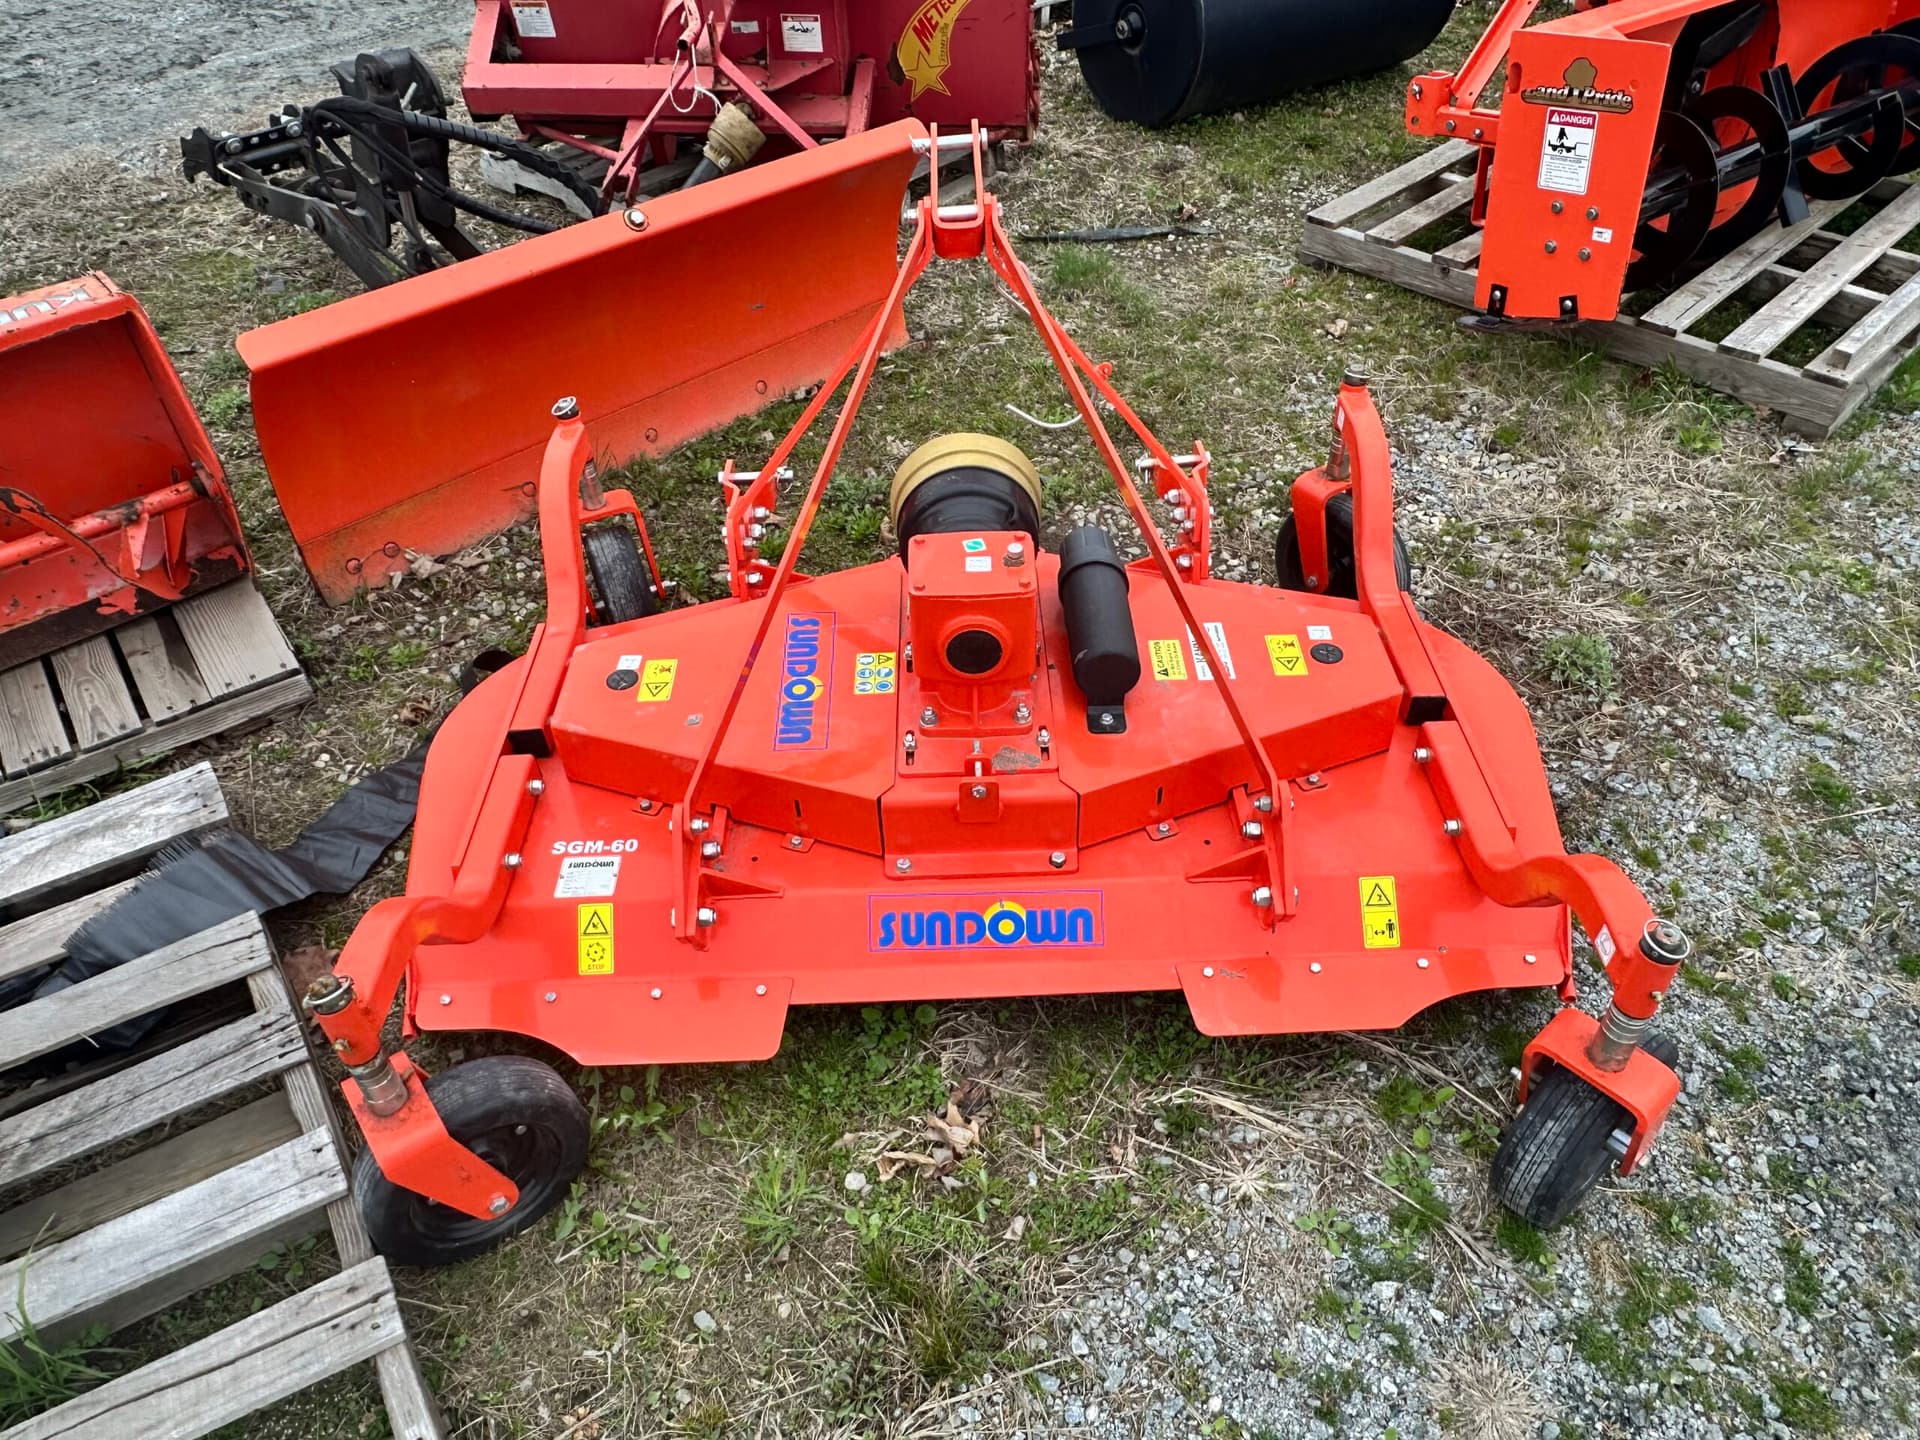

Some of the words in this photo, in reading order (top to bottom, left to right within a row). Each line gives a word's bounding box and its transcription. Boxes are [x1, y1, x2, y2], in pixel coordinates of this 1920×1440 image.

[1584, 87, 1632, 102] Pride
[1560, 113, 1593, 126] DANGER
[1153, 641, 1165, 669] CAUTION
[777, 618, 820, 744] SUNDOWN
[551, 839, 639, 855] SGM-60
[878, 907, 1094, 947] SUNDOWN
